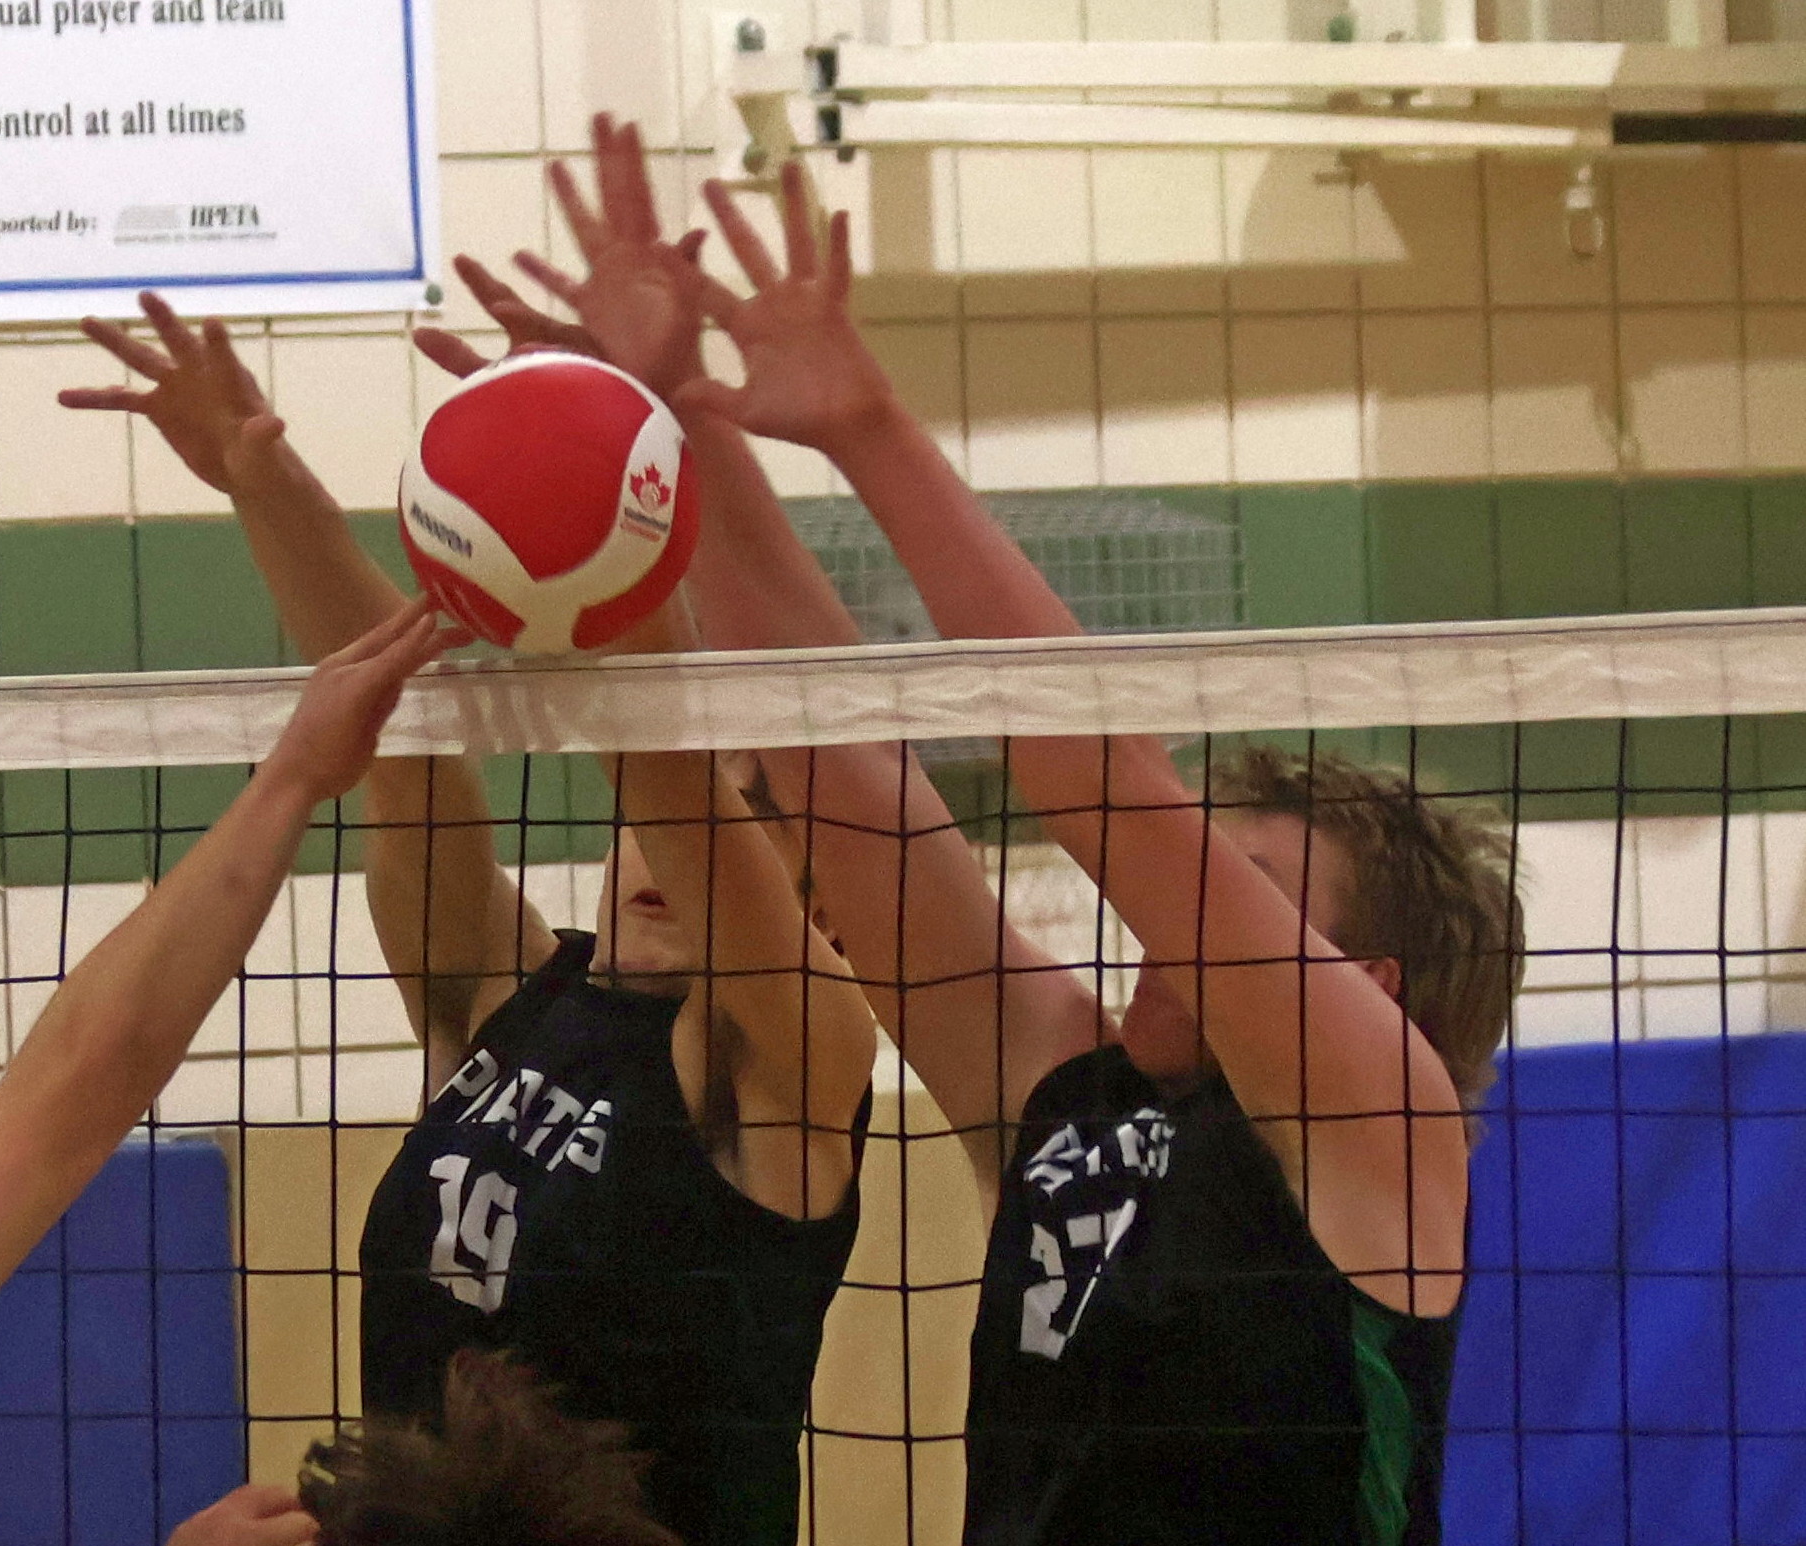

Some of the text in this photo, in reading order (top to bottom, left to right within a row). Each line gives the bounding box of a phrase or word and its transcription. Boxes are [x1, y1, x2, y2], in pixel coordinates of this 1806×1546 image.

[53, 0, 141, 35] player
[152, 0, 206, 25] and
[216, 0, 286, 23] team
[84, 108, 111, 137] at
[121, 101, 157, 137] all
[167, 103, 247, 135] times
[429, 1153, 518, 1314] 19
